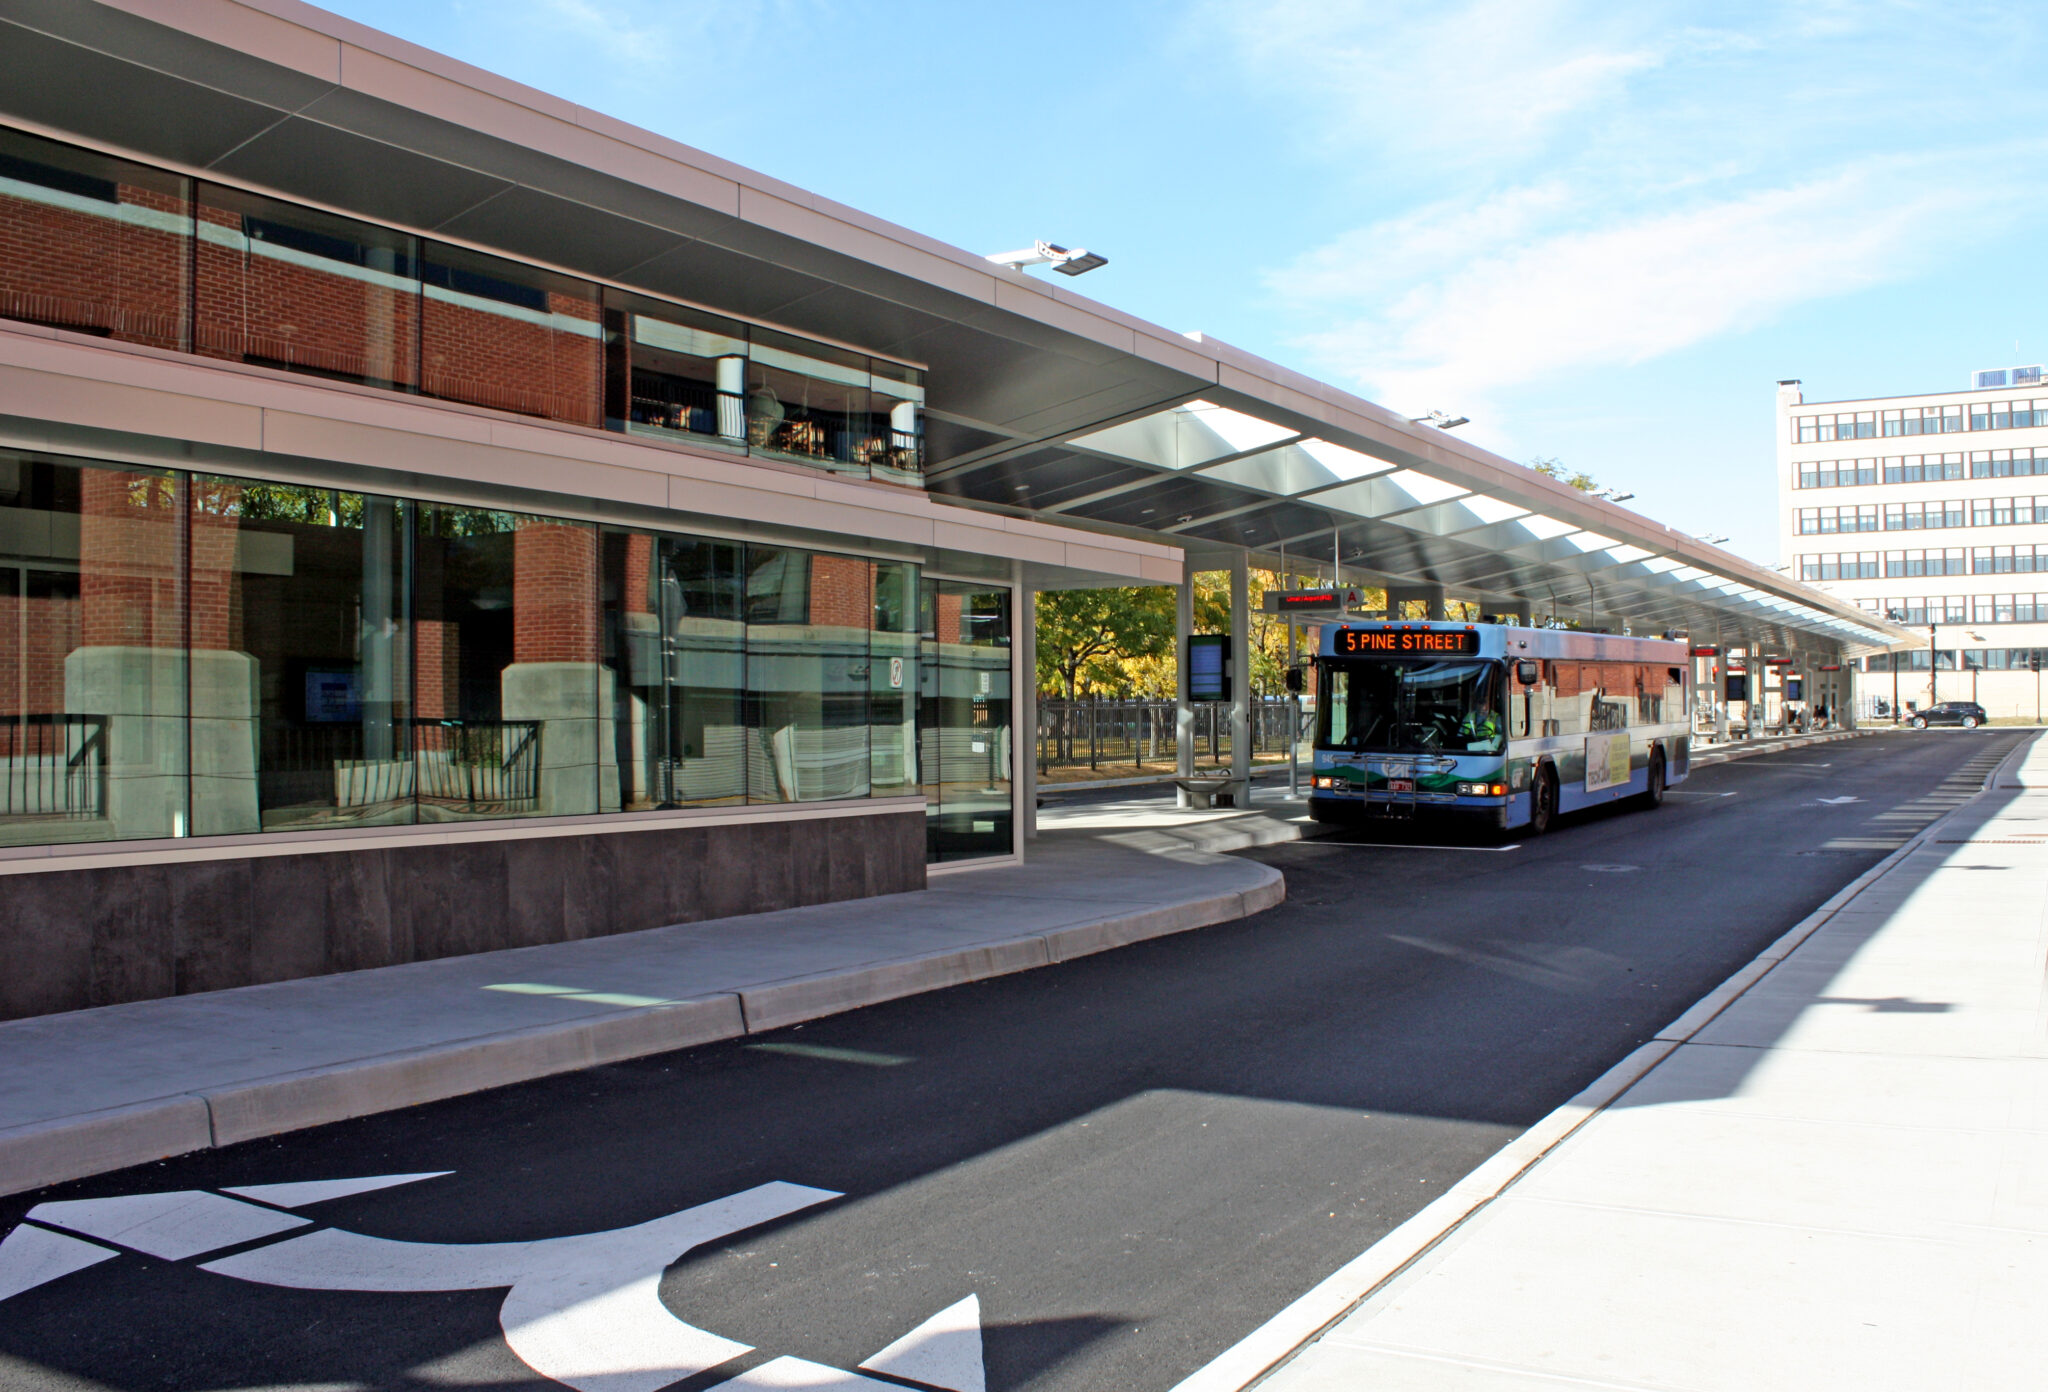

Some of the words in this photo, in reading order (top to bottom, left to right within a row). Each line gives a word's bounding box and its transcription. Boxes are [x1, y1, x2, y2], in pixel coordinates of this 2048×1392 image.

[1347, 591, 1357, 602] A
[1347, 632, 1356, 651] 5
[1361, 634, 1396, 649] PINE
[1402, 634, 1465, 650] STREET
